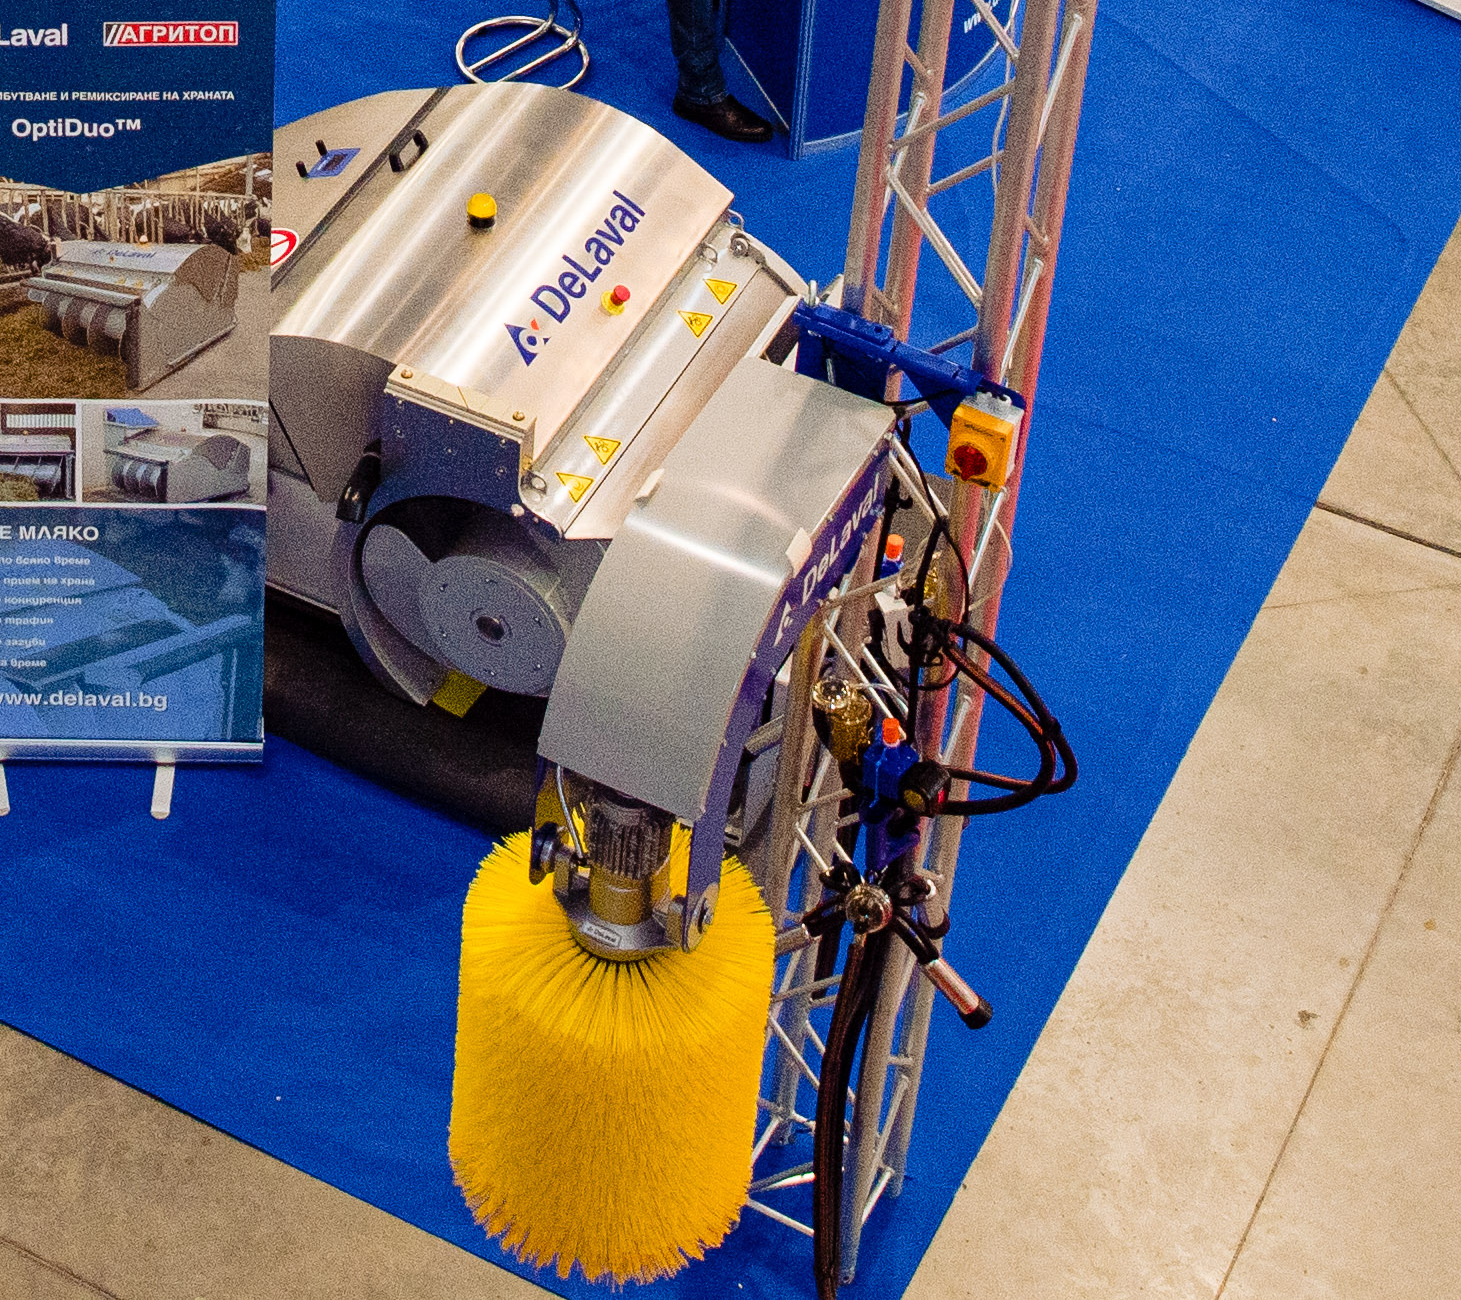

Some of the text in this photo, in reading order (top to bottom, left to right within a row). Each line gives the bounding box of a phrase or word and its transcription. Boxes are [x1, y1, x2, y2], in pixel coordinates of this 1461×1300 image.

[120, 23, 235, 44] АГРИТОП
[60, 91, 70, 101] И
[71, 91, 161, 102] РЕМИКСИРАНЕ
[162, 91, 180, 101] НА
[182, 90, 236, 101] ХРАНАТА
[528, 186, 647, 326] DeLaval
[18, 525, 100, 541] МЛЯКО
[801, 471, 880, 606] DeLaval
